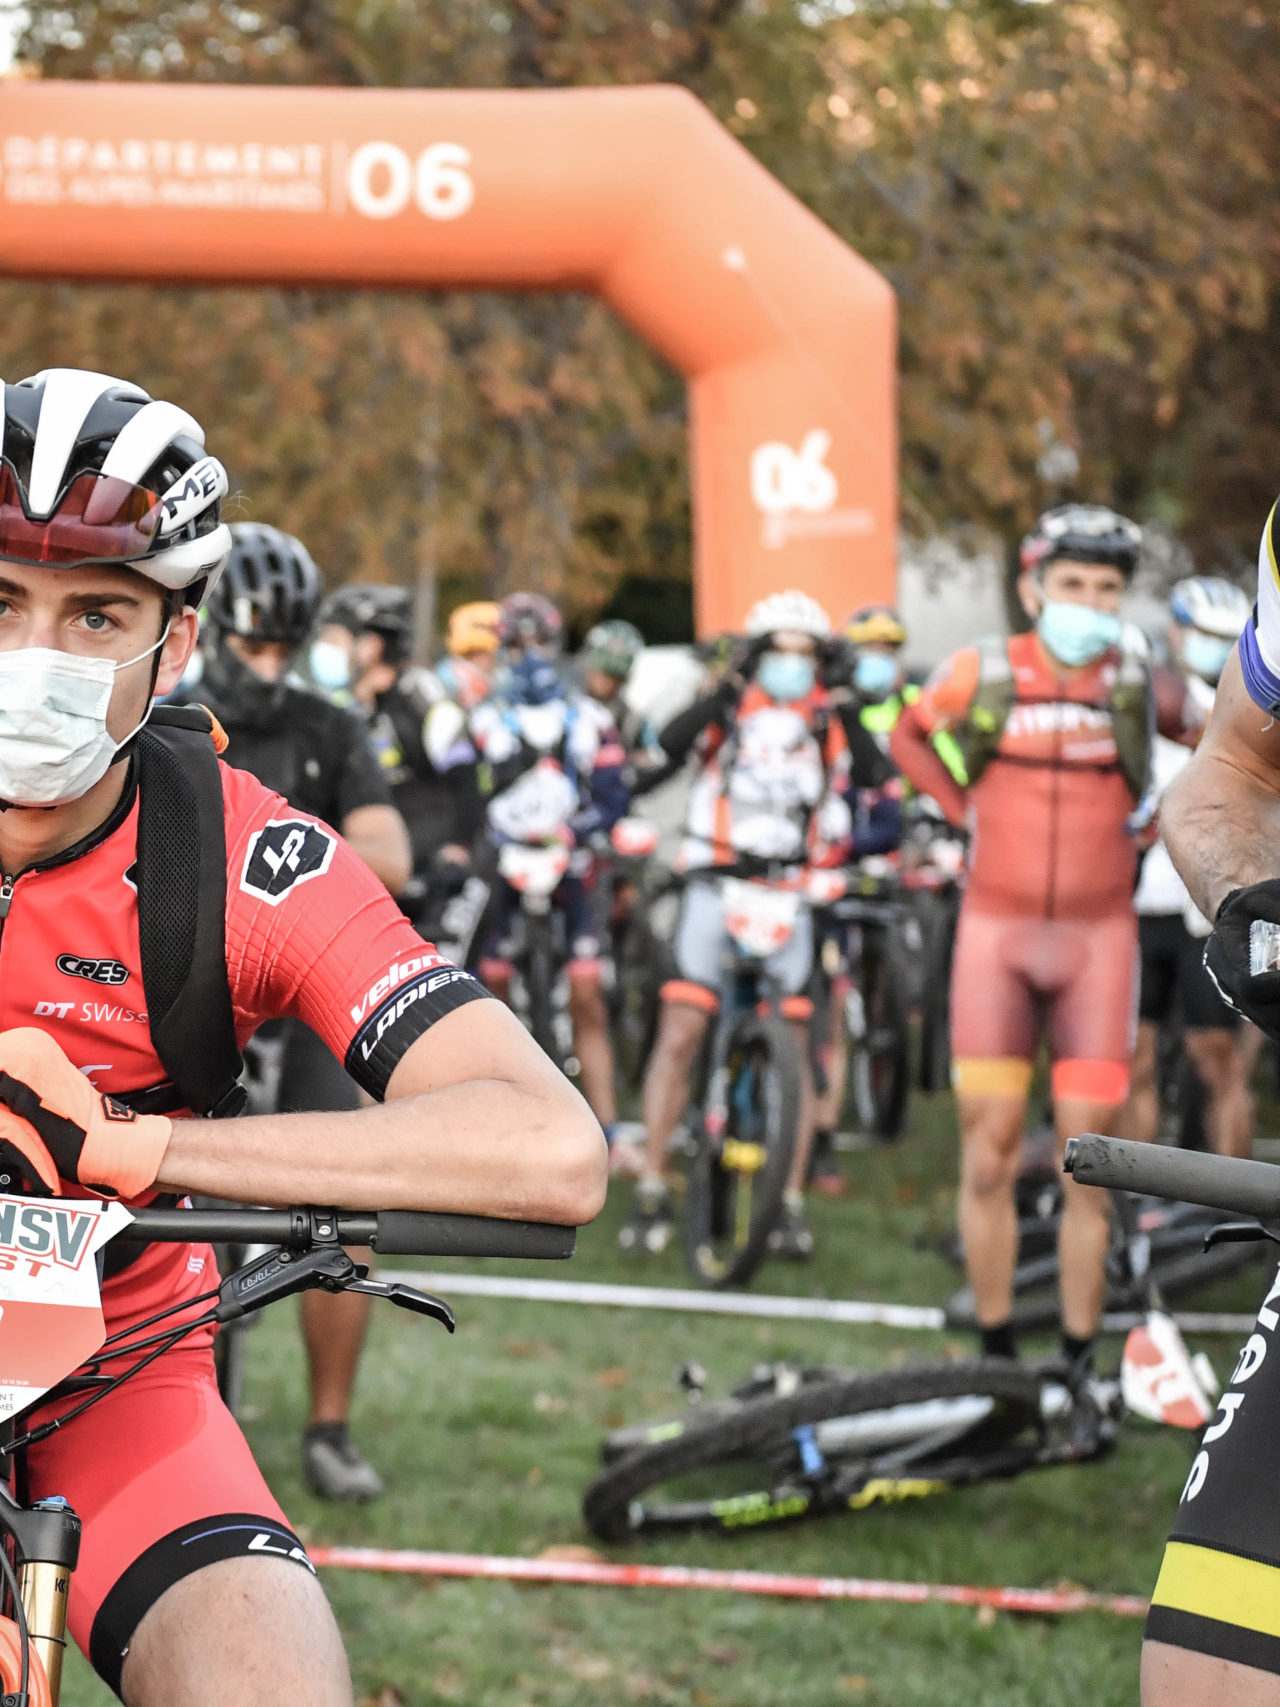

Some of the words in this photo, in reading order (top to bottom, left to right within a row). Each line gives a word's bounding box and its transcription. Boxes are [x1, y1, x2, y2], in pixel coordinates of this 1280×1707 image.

[348, 140, 475, 221] 06
[749, 428, 838, 514] 06
[56, 953, 131, 985] CRES
[33, 1001, 75, 1019] DT
[80, 1003, 149, 1023] SWISS
